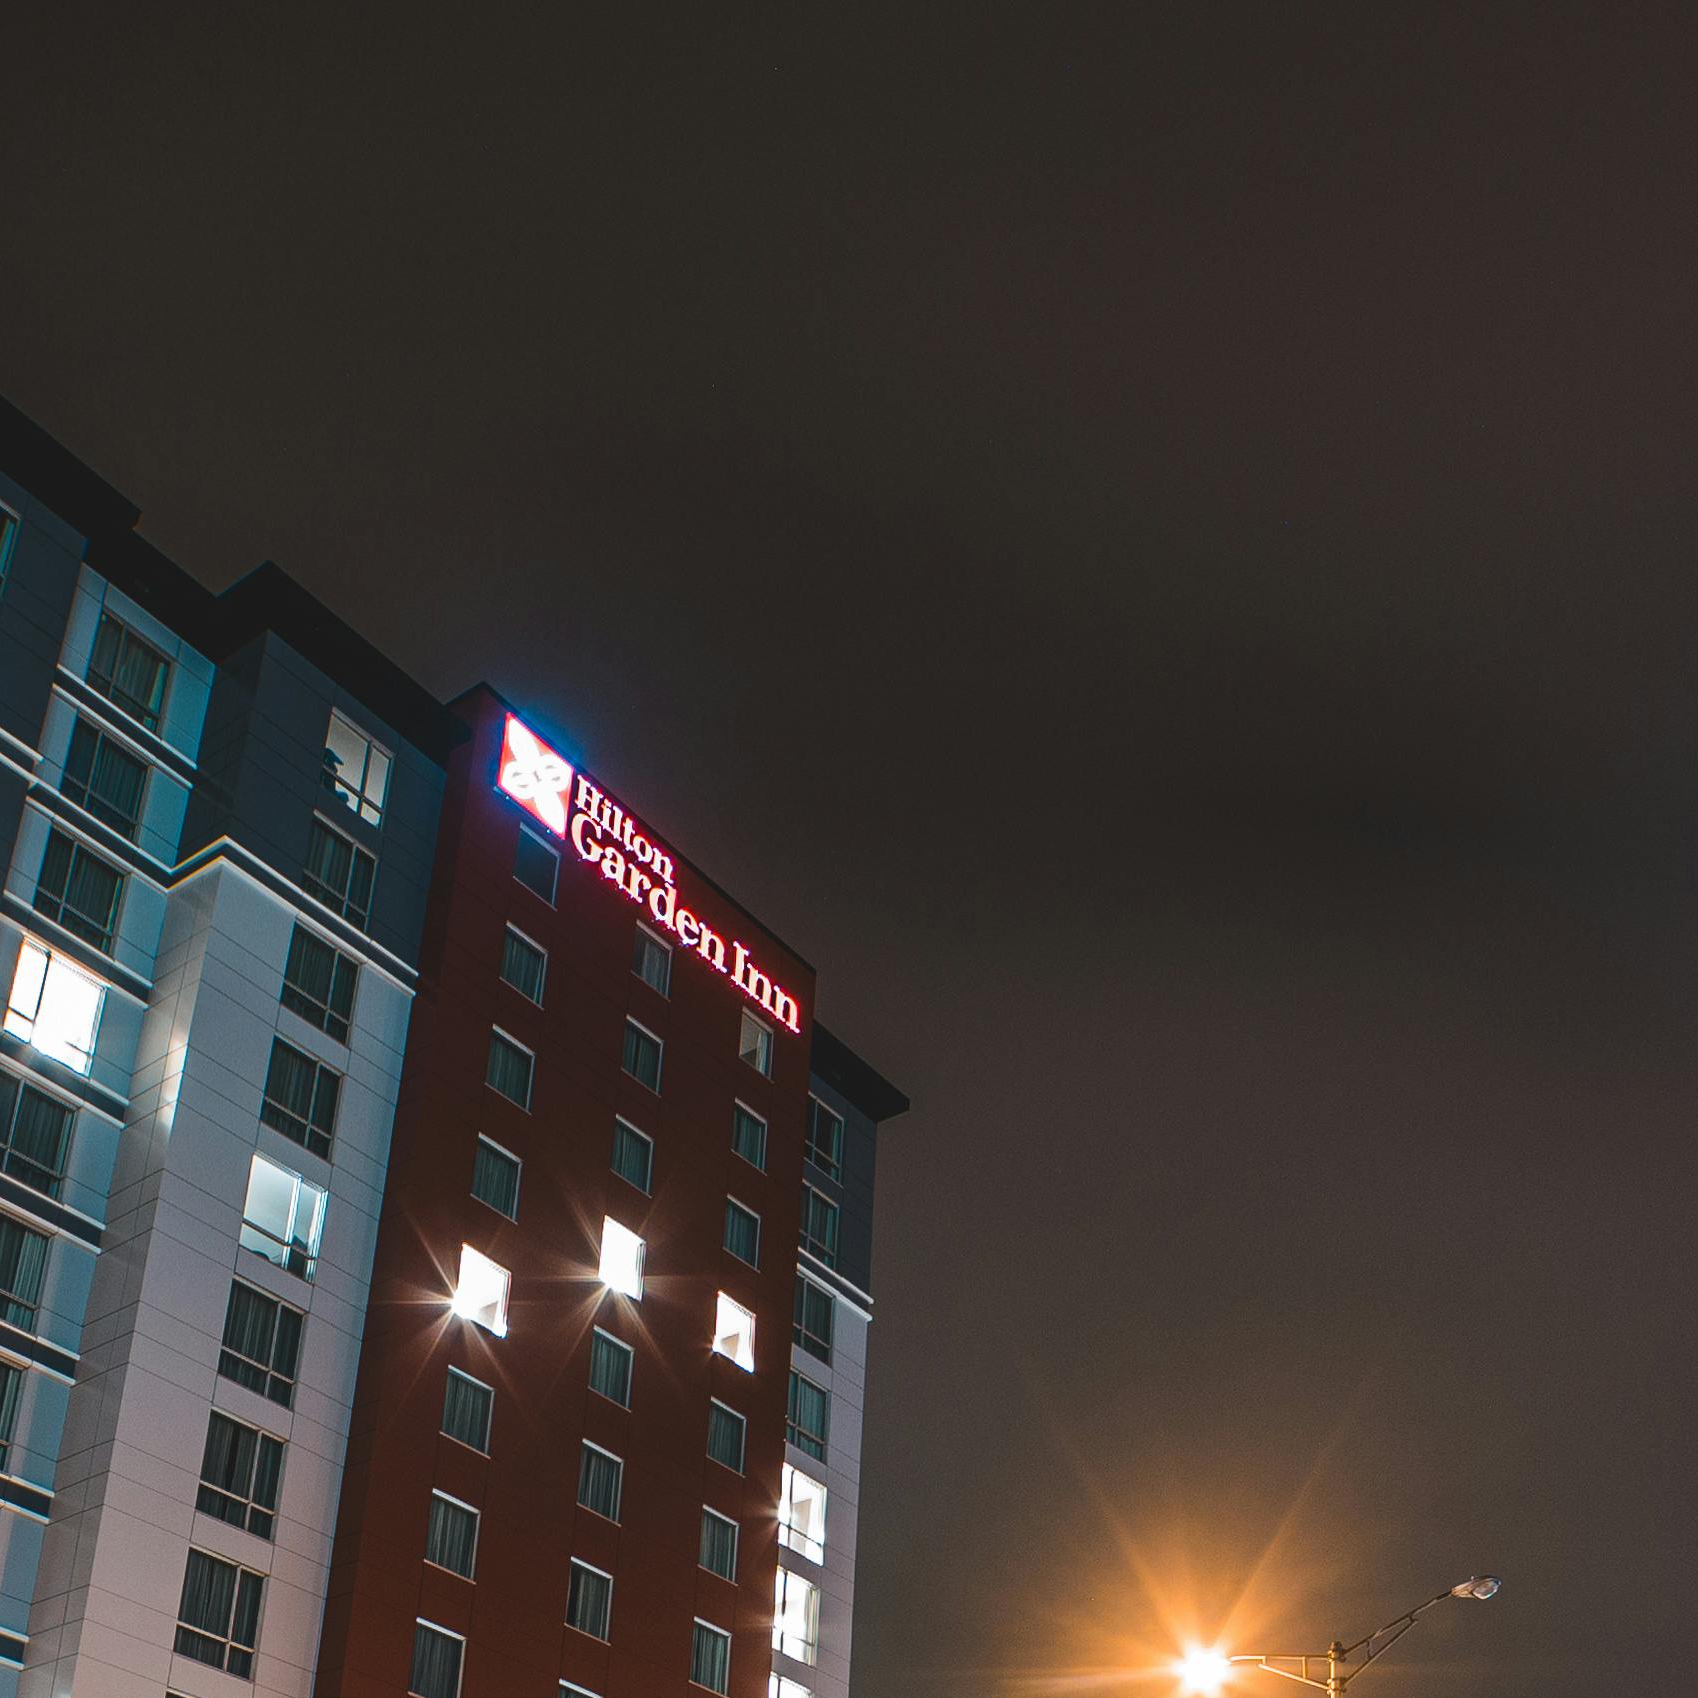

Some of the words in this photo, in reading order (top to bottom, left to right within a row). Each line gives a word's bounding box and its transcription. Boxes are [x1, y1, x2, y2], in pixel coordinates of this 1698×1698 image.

[574, 774, 674, 884] Hilton
[570, 812, 729, 974] Garden
[730, 940, 801, 1034] Inn
